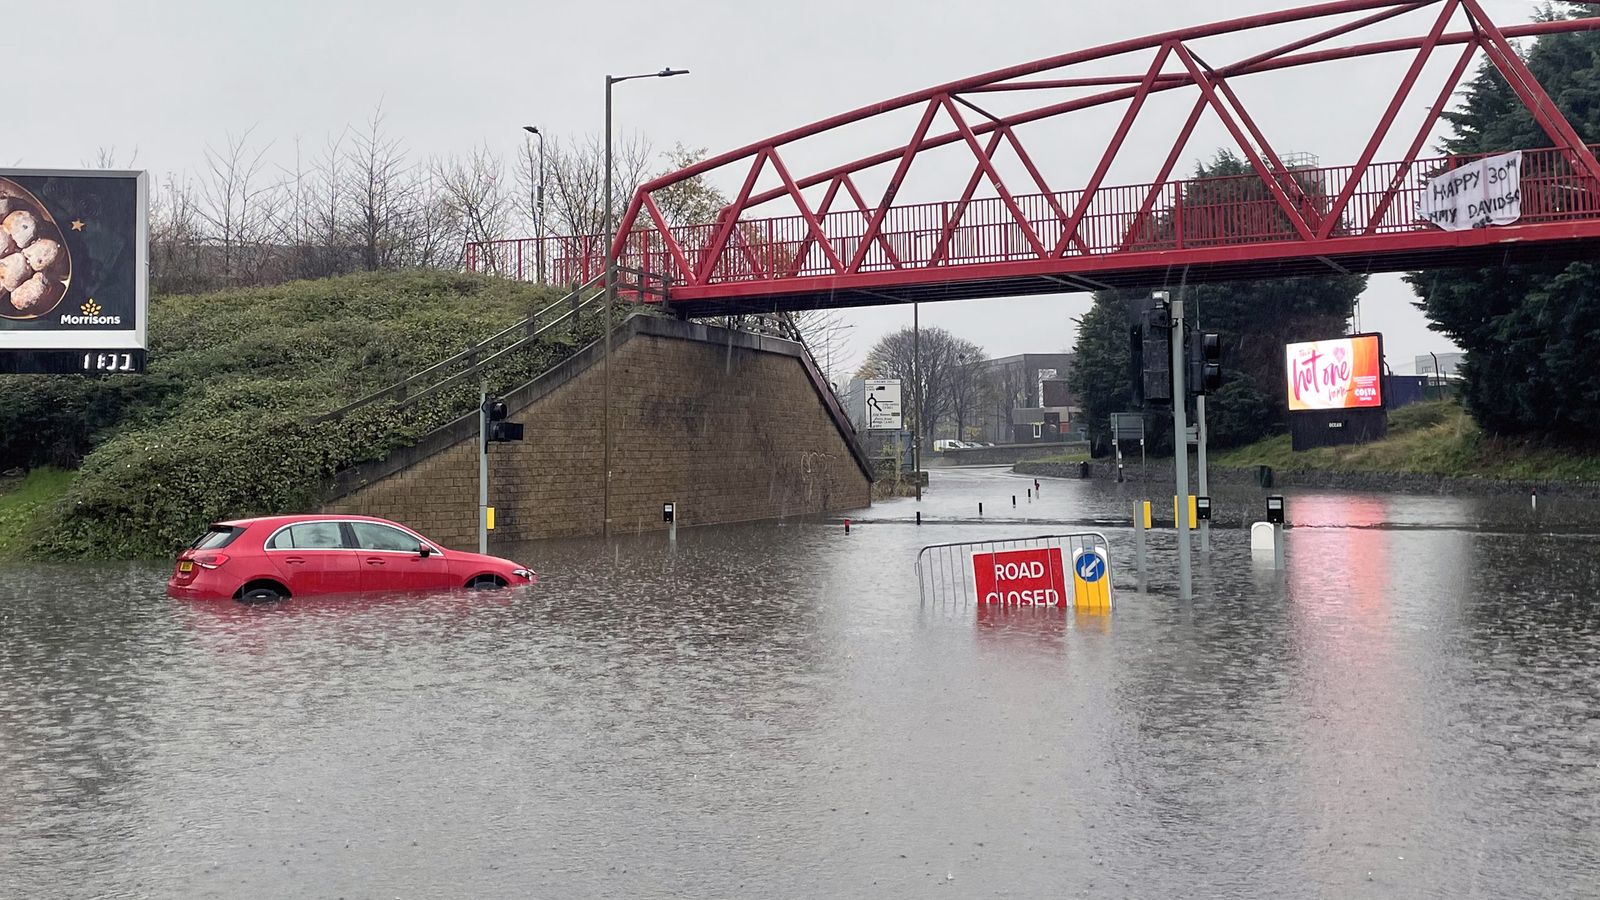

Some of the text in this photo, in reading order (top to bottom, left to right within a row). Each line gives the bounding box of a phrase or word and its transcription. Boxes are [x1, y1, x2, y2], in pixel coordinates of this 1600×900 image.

[1433, 170, 1480, 201] HAPPY
[60, 313, 121, 325] Morrisons
[1293, 349, 1350, 401] hot one
[1354, 387, 1377, 398] COSTA
[995, 561, 1045, 581] ROAD
